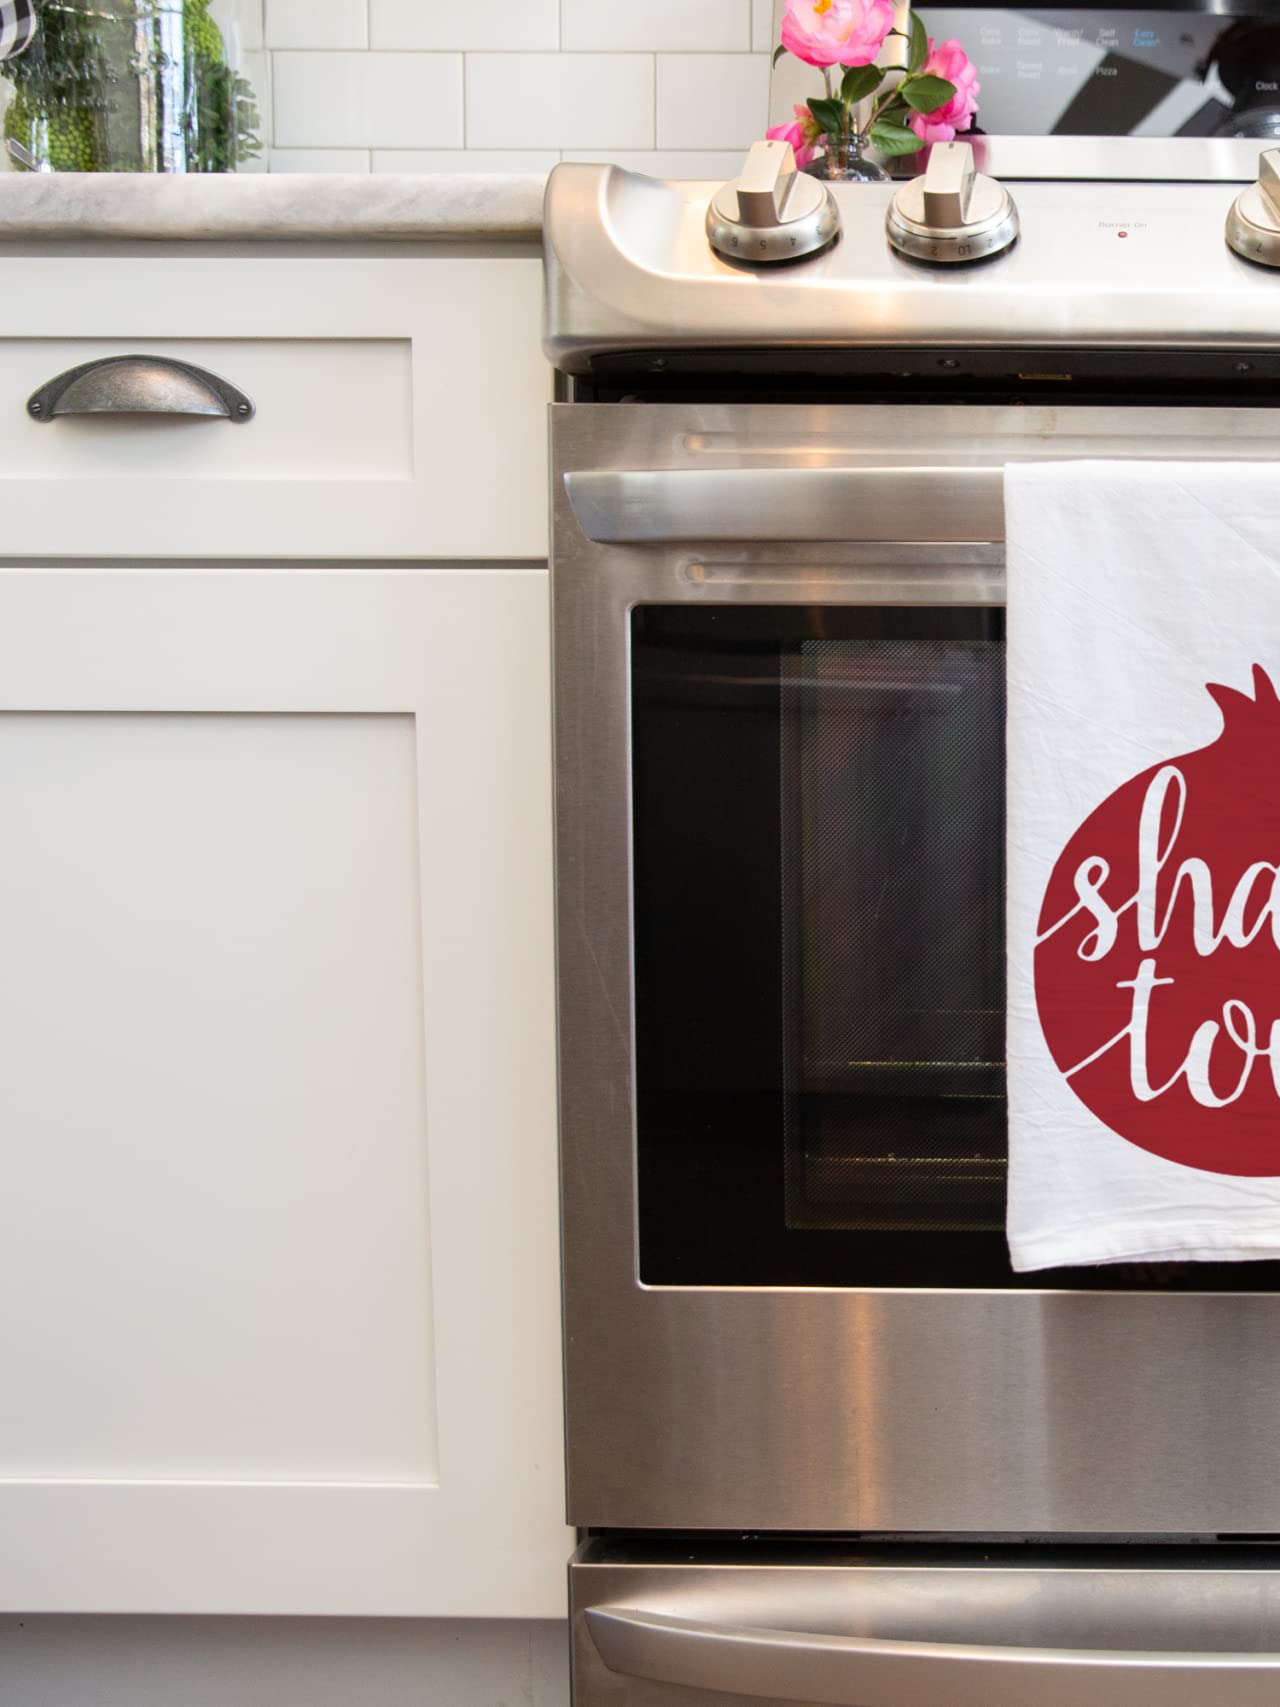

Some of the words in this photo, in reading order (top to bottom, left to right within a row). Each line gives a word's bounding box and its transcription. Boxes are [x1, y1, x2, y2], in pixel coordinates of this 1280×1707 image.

[1096, 38, 1119, 47] Clean
[1097, 67, 1118, 76] Pizza
[1256, 81, 1279, 91] Clock
